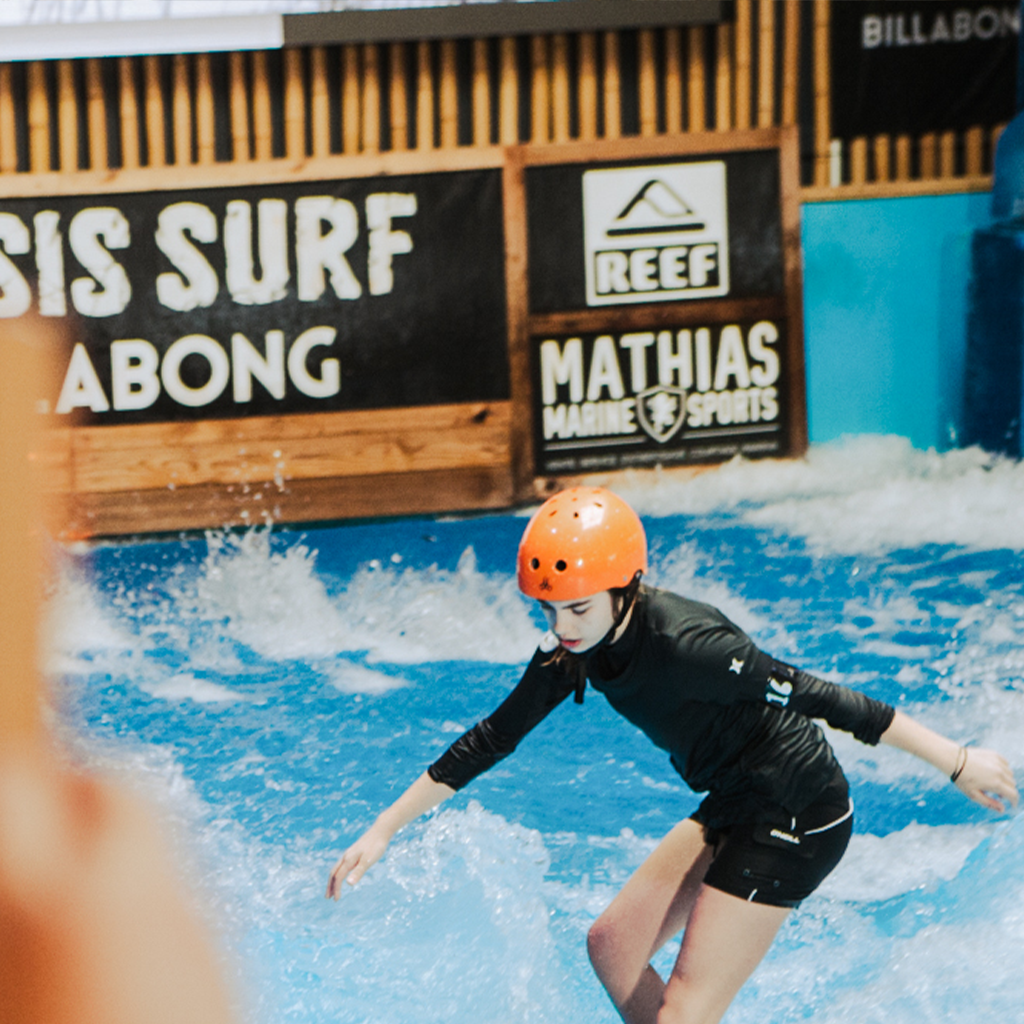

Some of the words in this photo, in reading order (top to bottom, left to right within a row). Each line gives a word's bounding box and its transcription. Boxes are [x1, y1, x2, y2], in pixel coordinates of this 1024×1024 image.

[156, 193, 418, 311] SURF
[596, 244, 717, 294] REEF
[38, 325, 341, 413] ABONG
[541, 321, 779, 405] MATHIAS
[543, 399, 638, 440] MARINE
[686, 386, 779, 427] SPORTS
